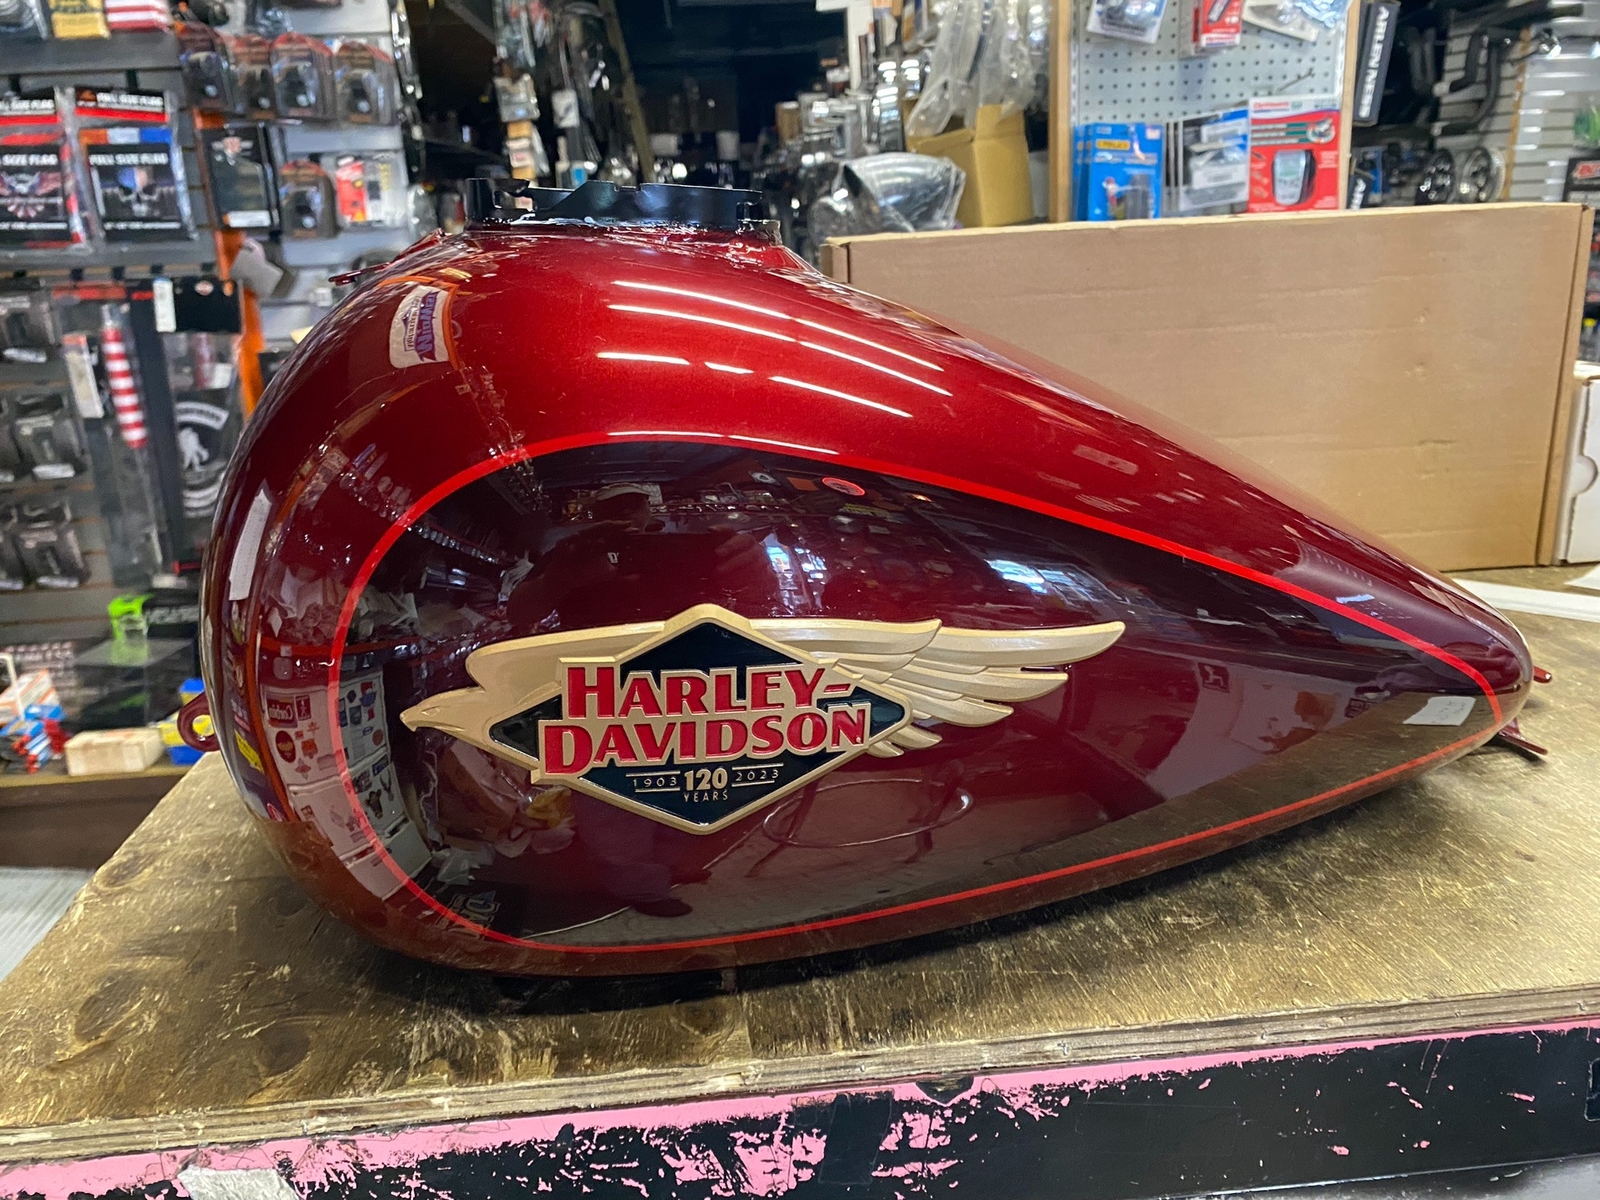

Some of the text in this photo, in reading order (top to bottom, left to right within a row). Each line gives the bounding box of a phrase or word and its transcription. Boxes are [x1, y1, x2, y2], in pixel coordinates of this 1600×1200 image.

[1358, 6, 1390, 118] ARLEN NESS
[2, 153, 58, 166] SIZE FLAG
[567, 667, 851, 719] HARLEY-
[544, 709, 866, 775] DAVIDSON
[633, 767, 779, 791] 1903 120 2023
[684, 790, 729, 803] YEARS
